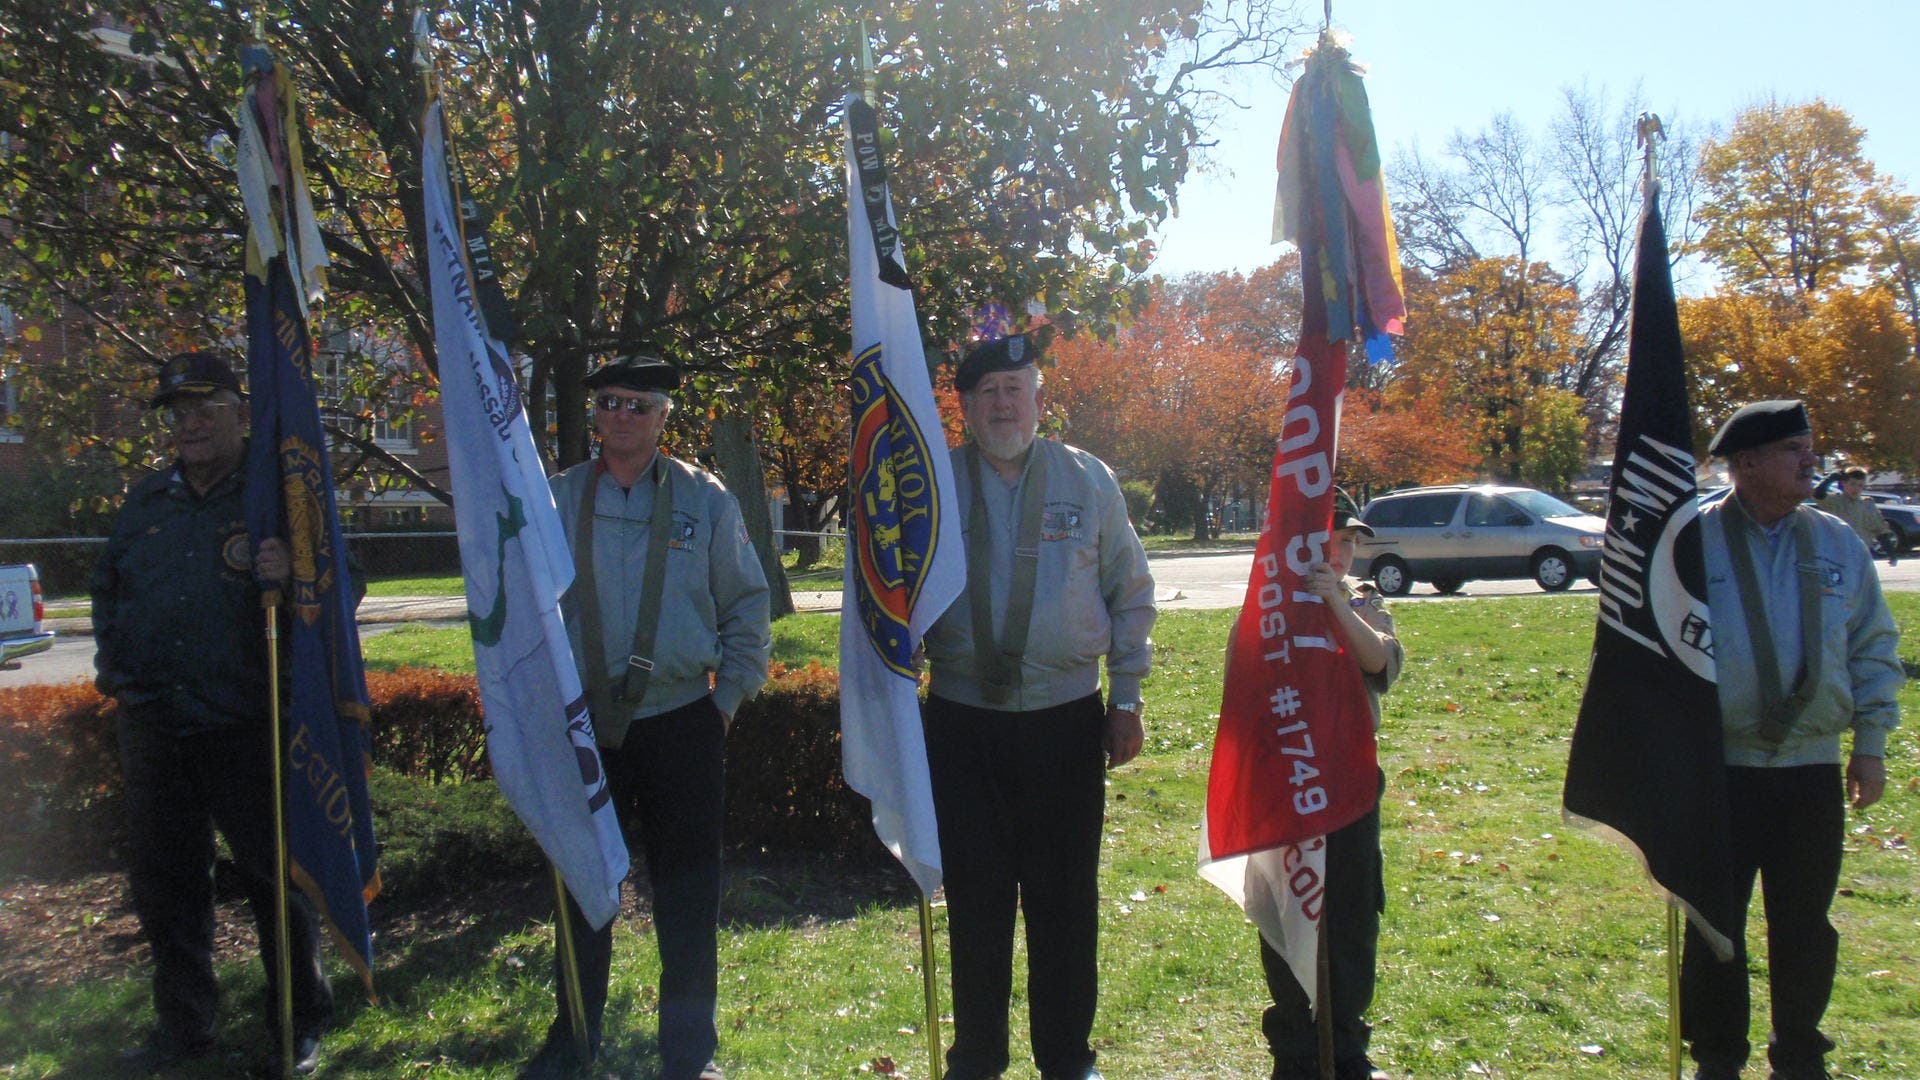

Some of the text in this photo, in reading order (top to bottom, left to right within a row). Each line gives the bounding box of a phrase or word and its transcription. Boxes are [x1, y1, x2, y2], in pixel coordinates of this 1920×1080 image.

[857, 132, 878, 171] POW
[467, 235, 494, 281] MIA
[1600, 523, 1668, 659] POW
[1257, 553, 1329, 816] POST #1749
